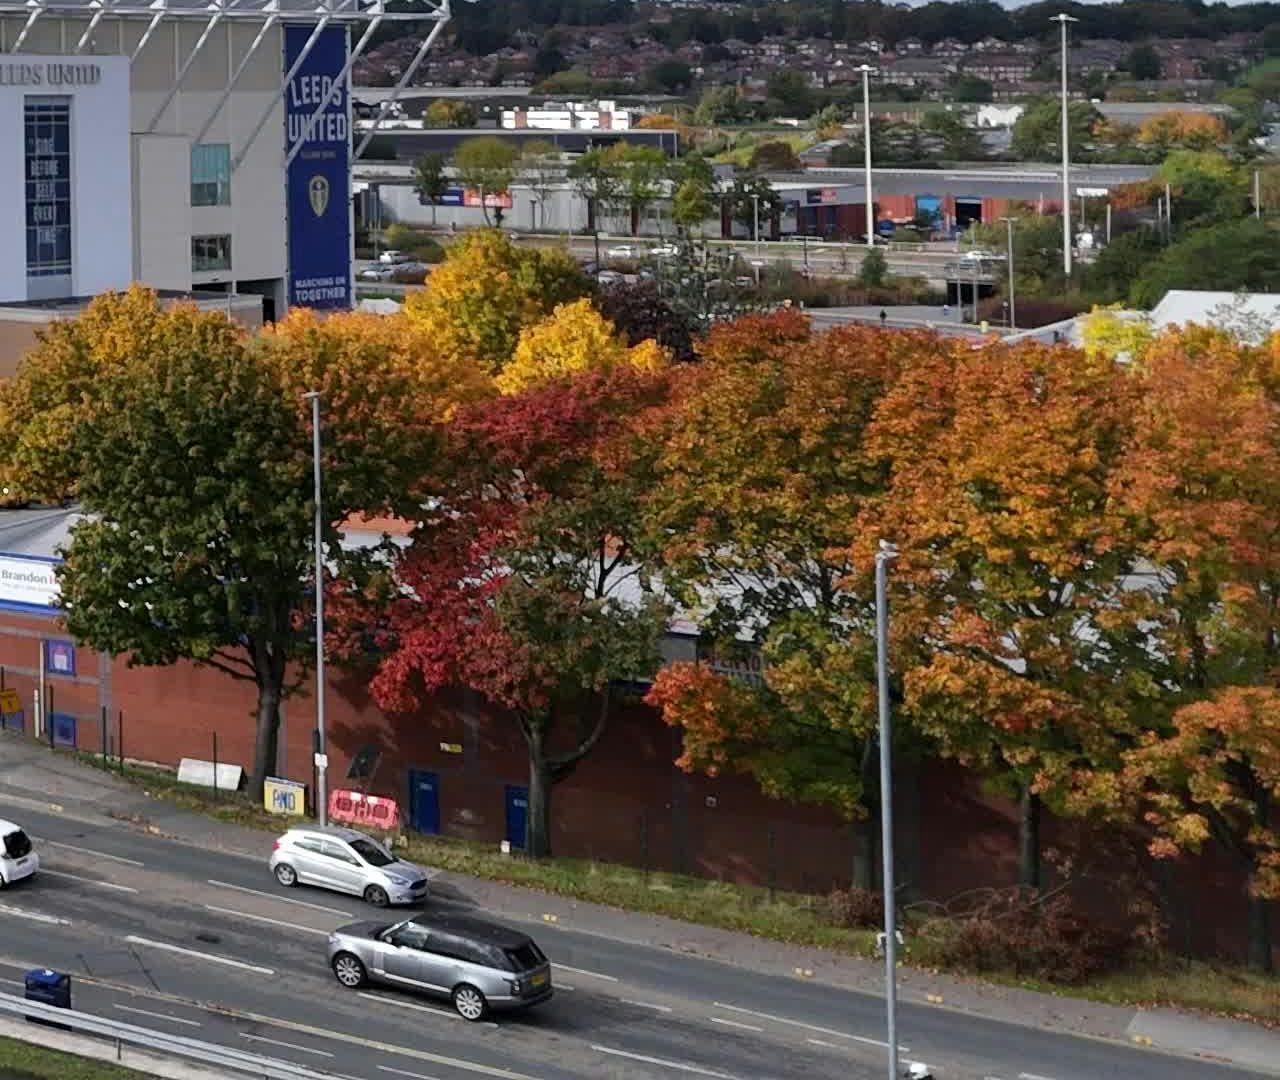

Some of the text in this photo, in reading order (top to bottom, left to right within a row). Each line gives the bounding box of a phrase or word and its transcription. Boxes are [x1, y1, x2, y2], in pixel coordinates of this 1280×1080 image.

[291, 75, 343, 108] LEEDS
[288, 113, 347, 142] UNITED
[2, 569, 48, 584] Brandon
